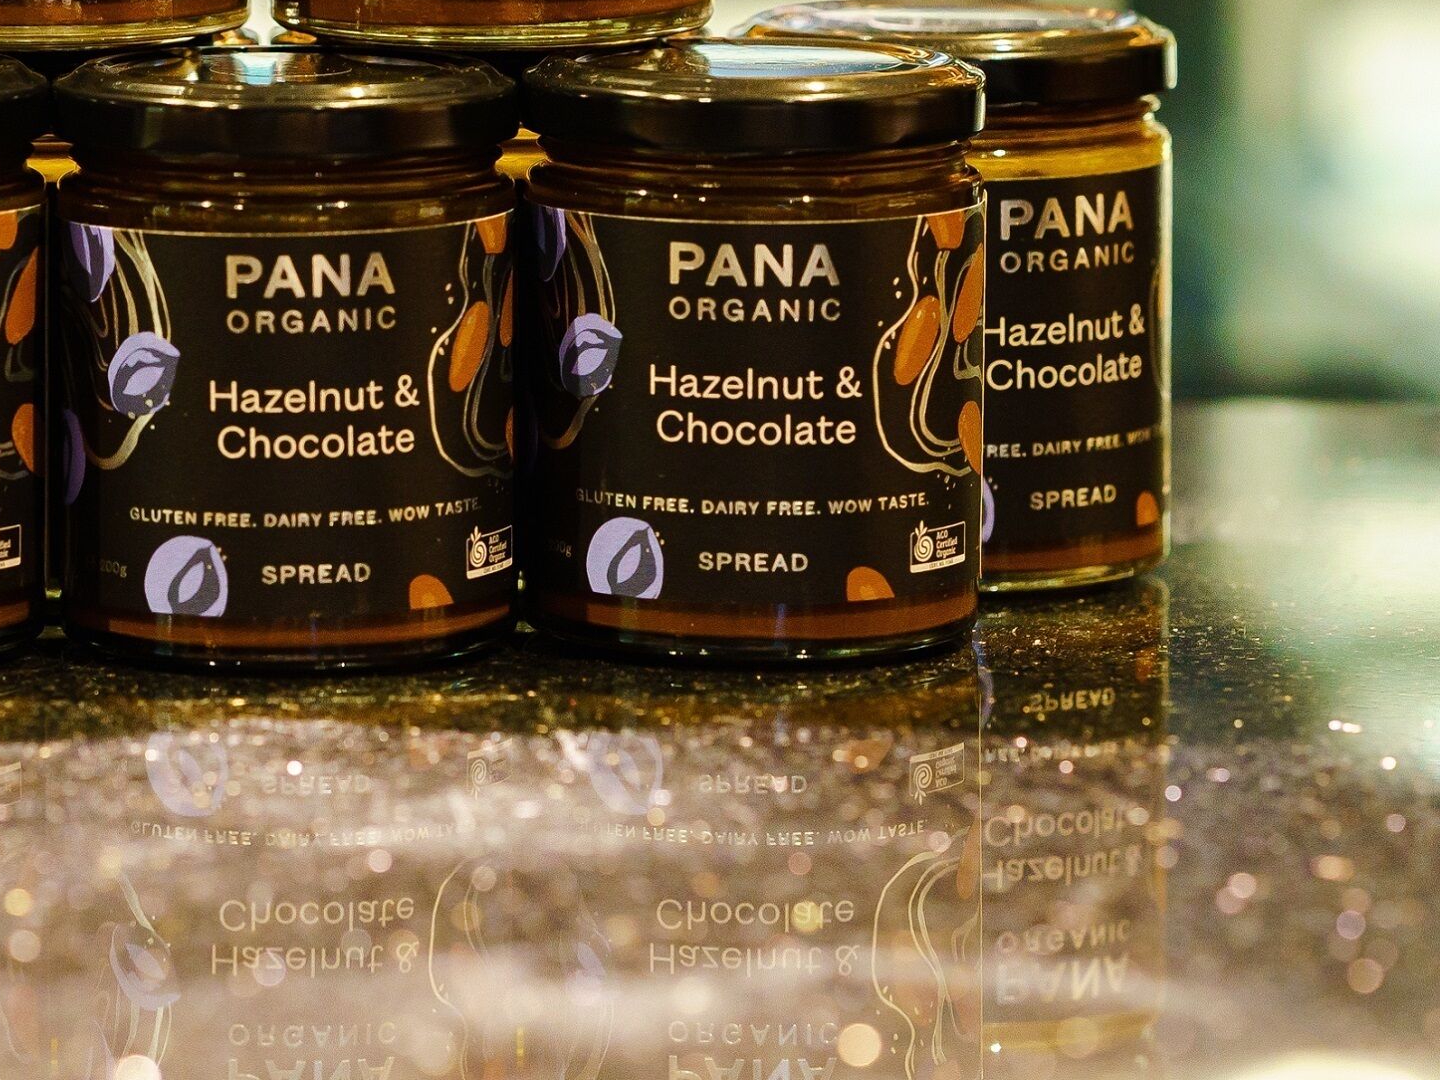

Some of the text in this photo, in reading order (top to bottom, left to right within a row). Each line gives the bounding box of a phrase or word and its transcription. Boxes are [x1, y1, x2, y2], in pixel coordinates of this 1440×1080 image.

[1000, 191, 1134, 241] PANA
[669, 242, 841, 288] PANA
[1000, 242, 1134, 274] ORGANIC
[225, 252, 394, 299] PANA
[226, 305, 396, 335] ORGANIC
[669, 296, 841, 322] ORGANIC
[1128, 304, 1145, 335] &
[649, 364, 862, 401] Hazelnut &
[986, 354, 1142, 392] Chocolate
[209, 374, 420, 414] Hazelnut &
[217, 424, 415, 459] Chocolate
[656, 410, 857, 446] Chocolate
[986, 442, 1027, 458] REE.
[1033, 440, 1080, 457] DAIRY
[575, 489, 929, 516] GLUTEN FREE. DAIRY FREE. WOW TASTE.
[1030, 485, 1117, 511] SPREAD
[130, 506, 197, 525] GLUTEN
[203, 511, 257, 528] FREE.
[264, 512, 321, 528] DAIRY
[329, 510, 382, 526] FREE.
[388, 506, 430, 523] WOW
[262, 563, 371, 585] SPREAD
[698, 552, 808, 573] SPREAD
